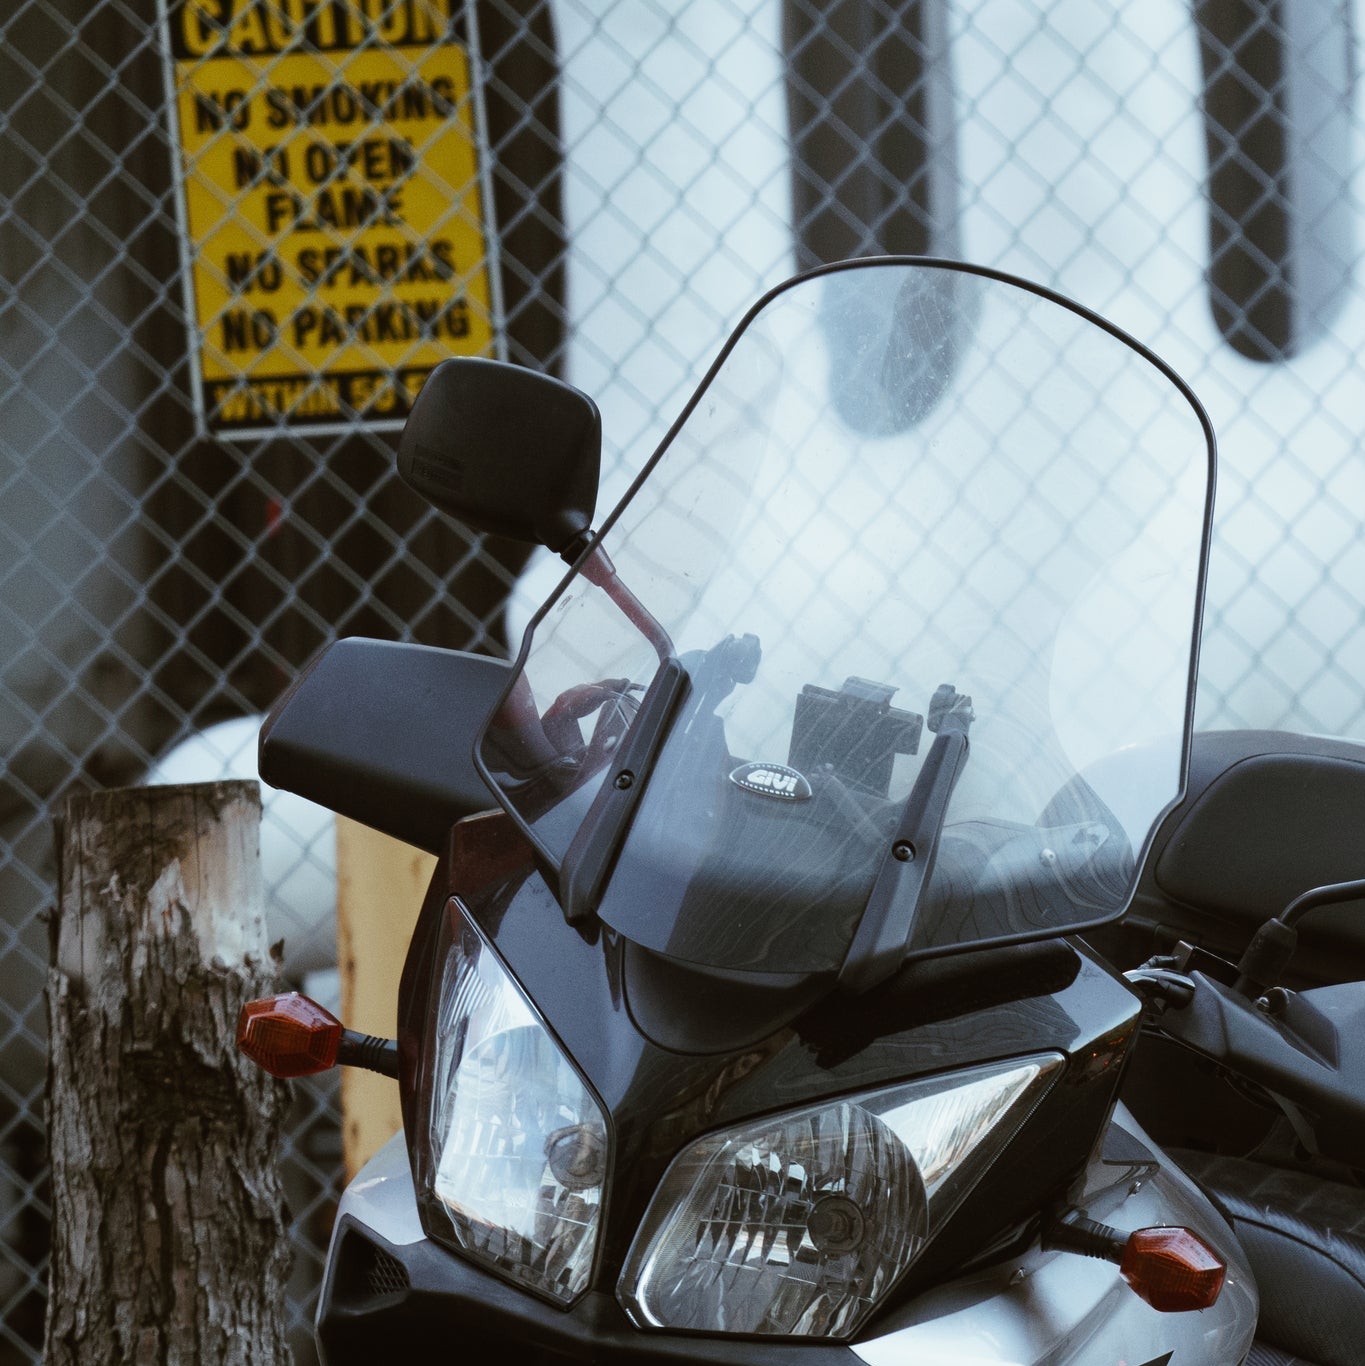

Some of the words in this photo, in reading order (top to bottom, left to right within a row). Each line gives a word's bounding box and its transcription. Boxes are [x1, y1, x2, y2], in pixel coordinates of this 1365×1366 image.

[182, 0, 451, 56] CAUTION
[194, 90, 250, 134] NO
[265, 76, 455, 130] SMOKING
[233, 145, 289, 189] NO
[304, 137, 415, 185] OPEN
[265, 187, 405, 234] FLAME
[225, 249, 283, 294] NO
[296, 240, 455, 289] SPARKS
[220, 307, 278, 352] NO
[294, 298, 471, 349] PARKING
[746, 769, 798, 792] GIVI
